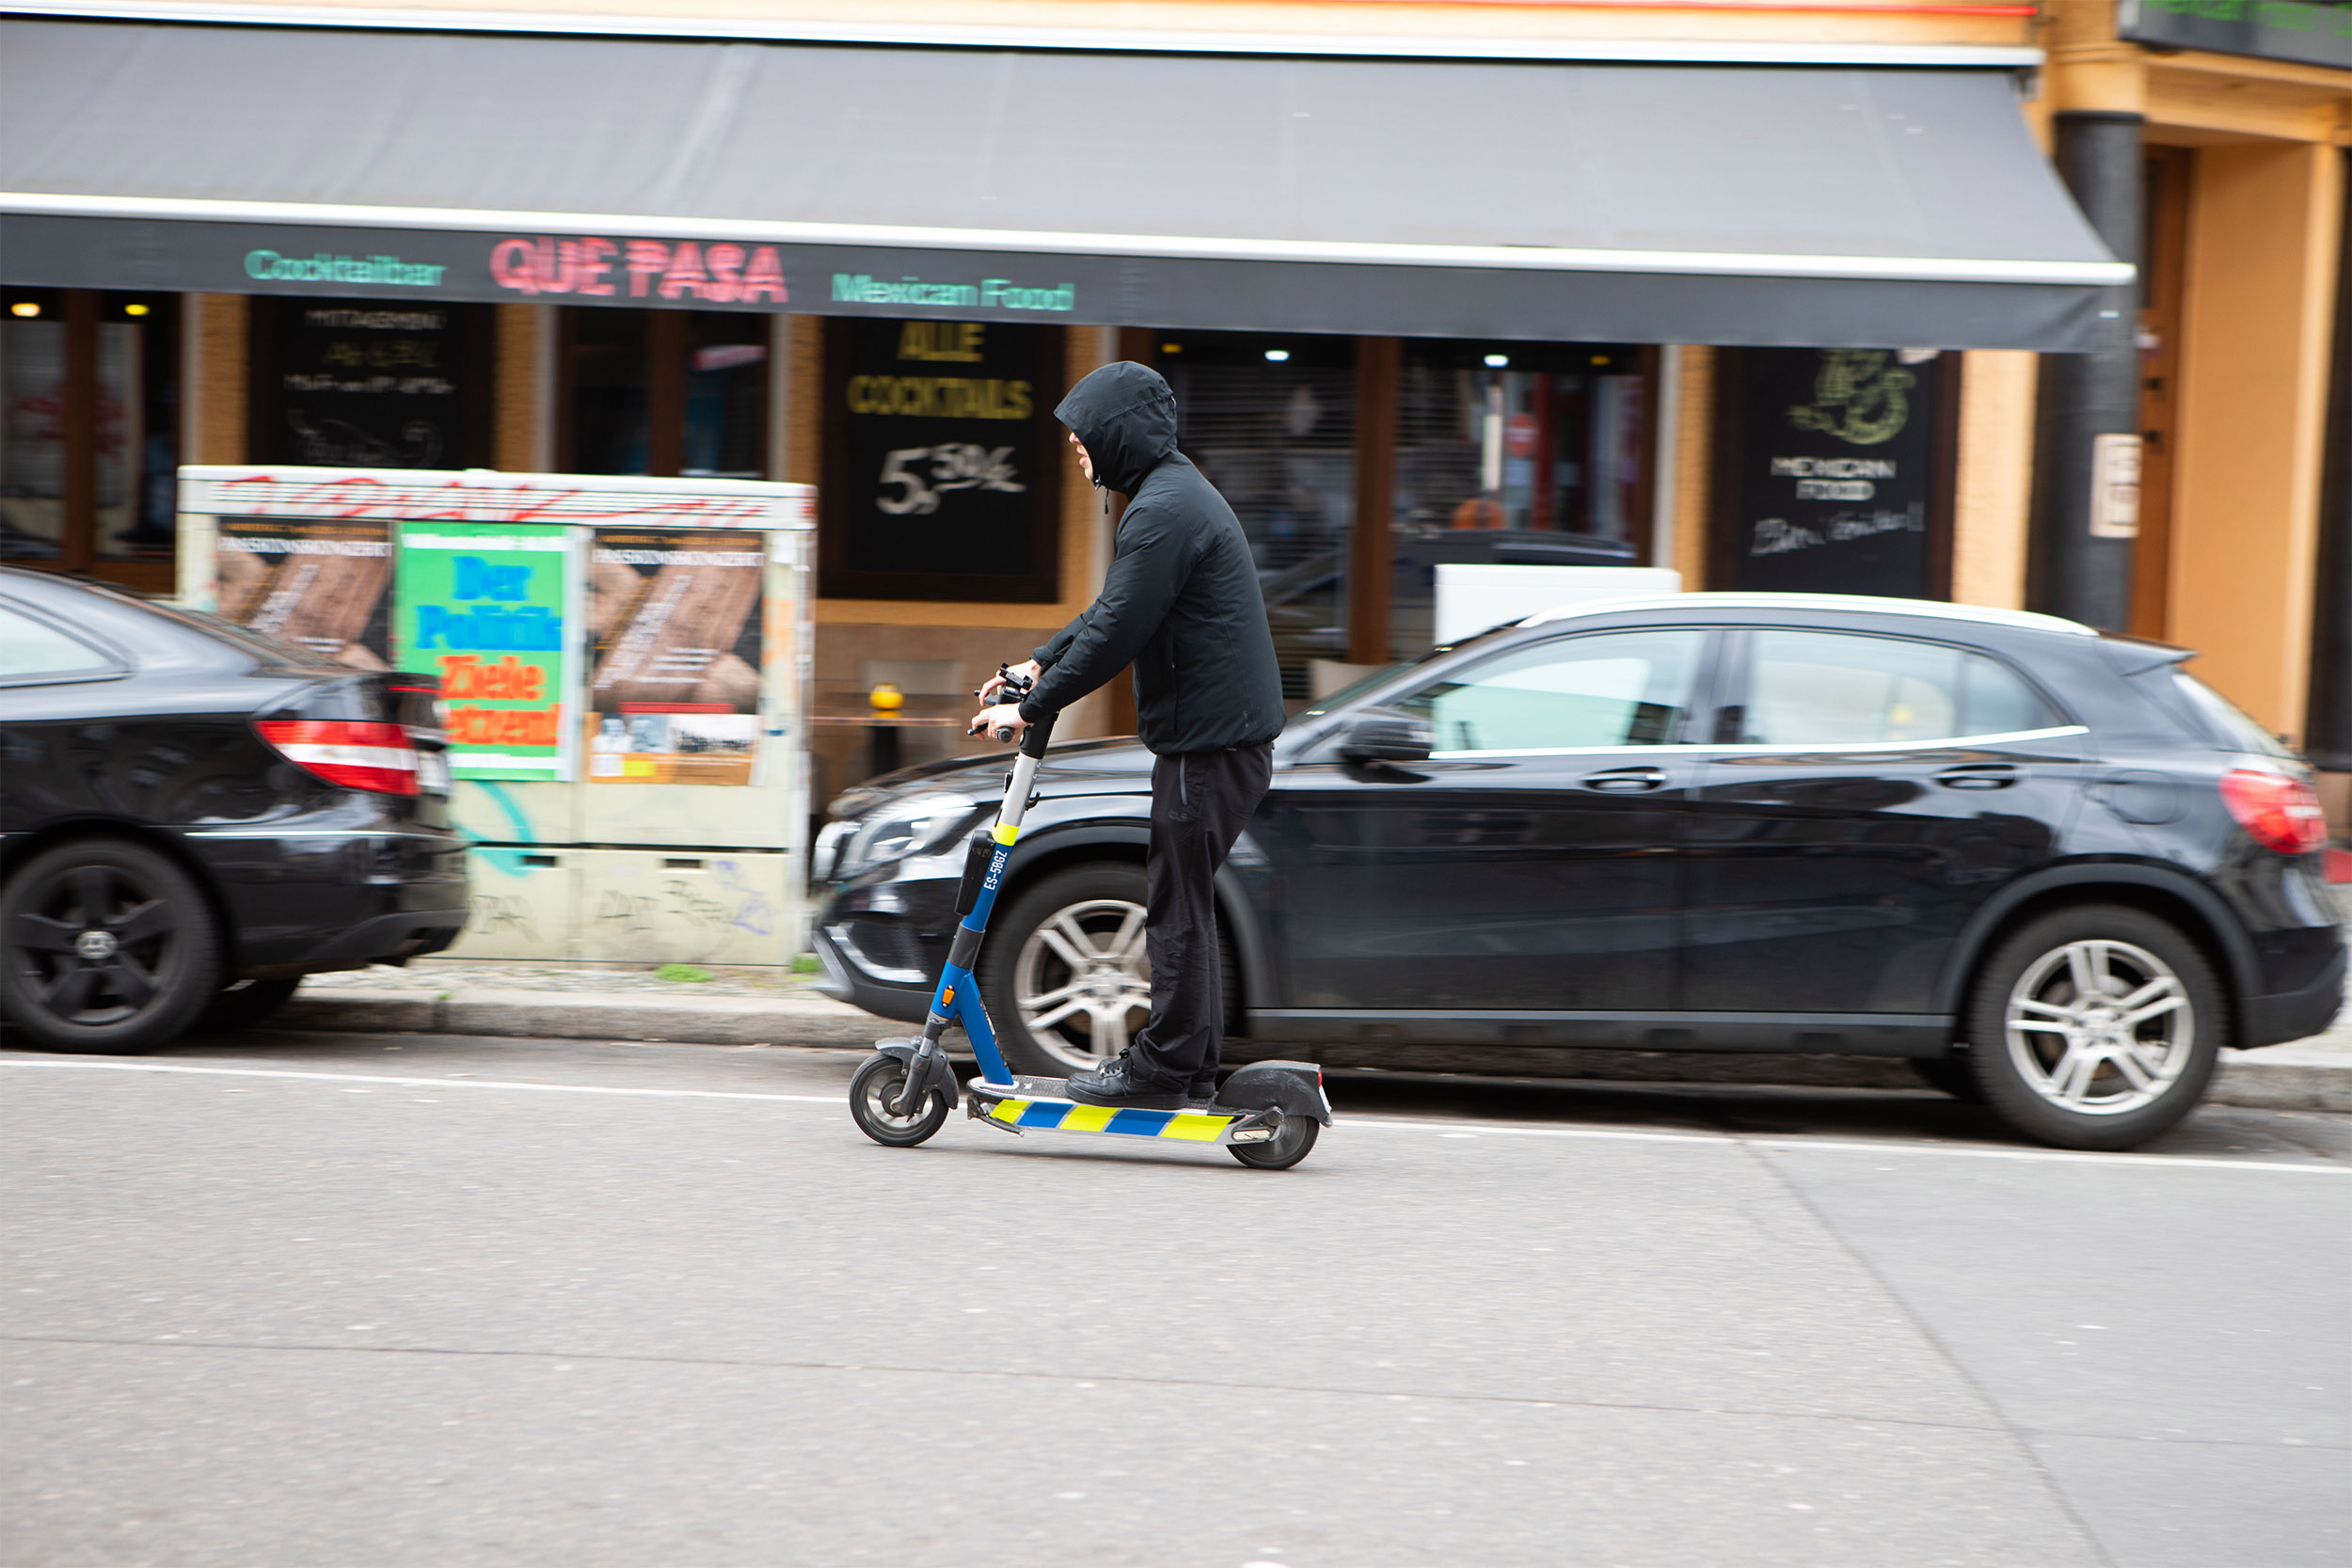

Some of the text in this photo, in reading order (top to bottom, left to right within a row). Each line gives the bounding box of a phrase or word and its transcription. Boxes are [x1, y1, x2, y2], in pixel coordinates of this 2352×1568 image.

[244, 249, 448, 286] Cocktailbar
[489, 236, 788, 304] QUE PASA
[832, 273, 1074, 310] Mexican Food
[897, 321, 986, 362] ALLE
[846, 375, 1033, 420] COCKTAILS
[1770, 456, 1897, 479] MEXICAN
[1795, 481, 1875, 500] FOOD
[452, 555, 534, 602] Der
[435, 654, 548, 702] Ziele
[983, 849, 1008, 891] ES-5BGZ
